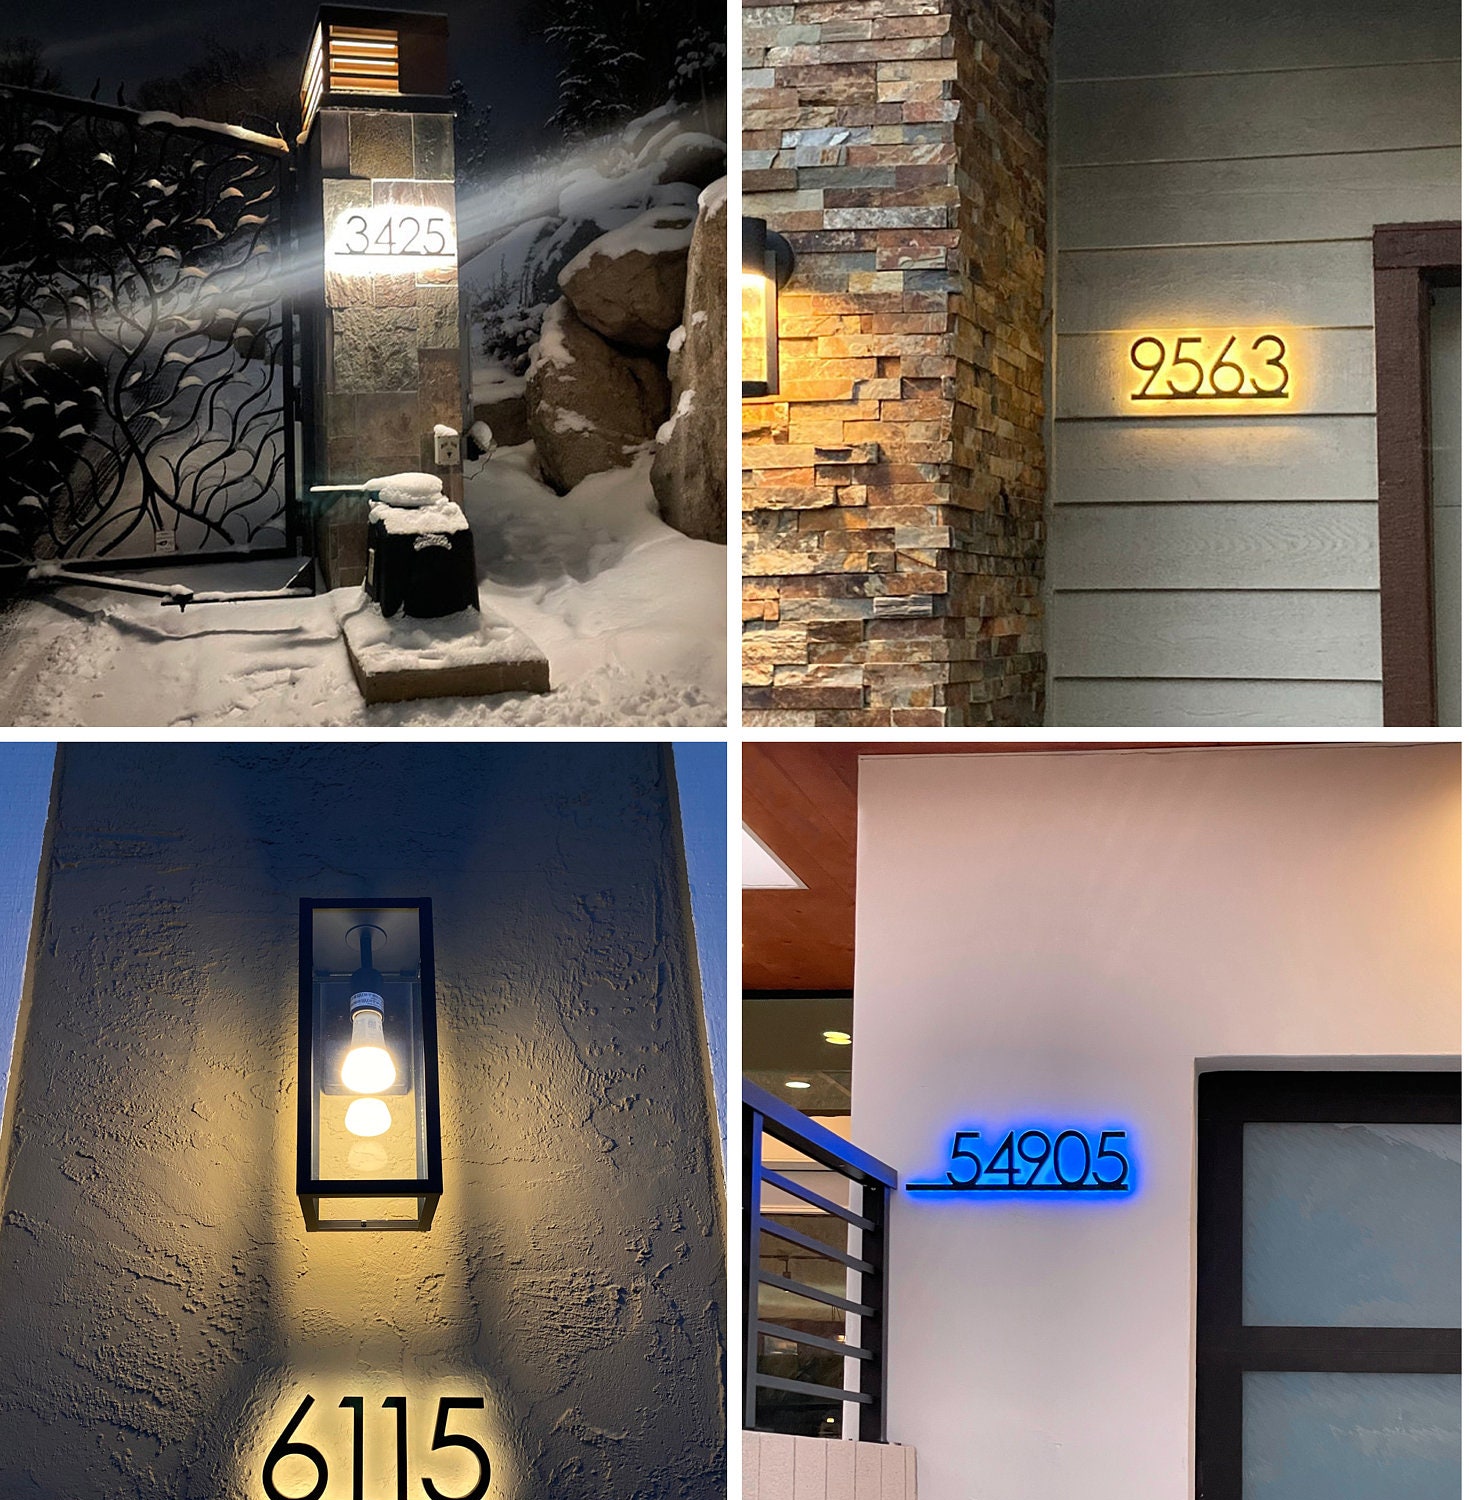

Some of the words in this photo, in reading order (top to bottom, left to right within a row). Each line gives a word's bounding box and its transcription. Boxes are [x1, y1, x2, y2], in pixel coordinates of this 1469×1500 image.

[346, 216, 446, 255] 3425
[1131, 335, 1289, 398] 9563
[947, 1130, 1129, 1188] 54905
